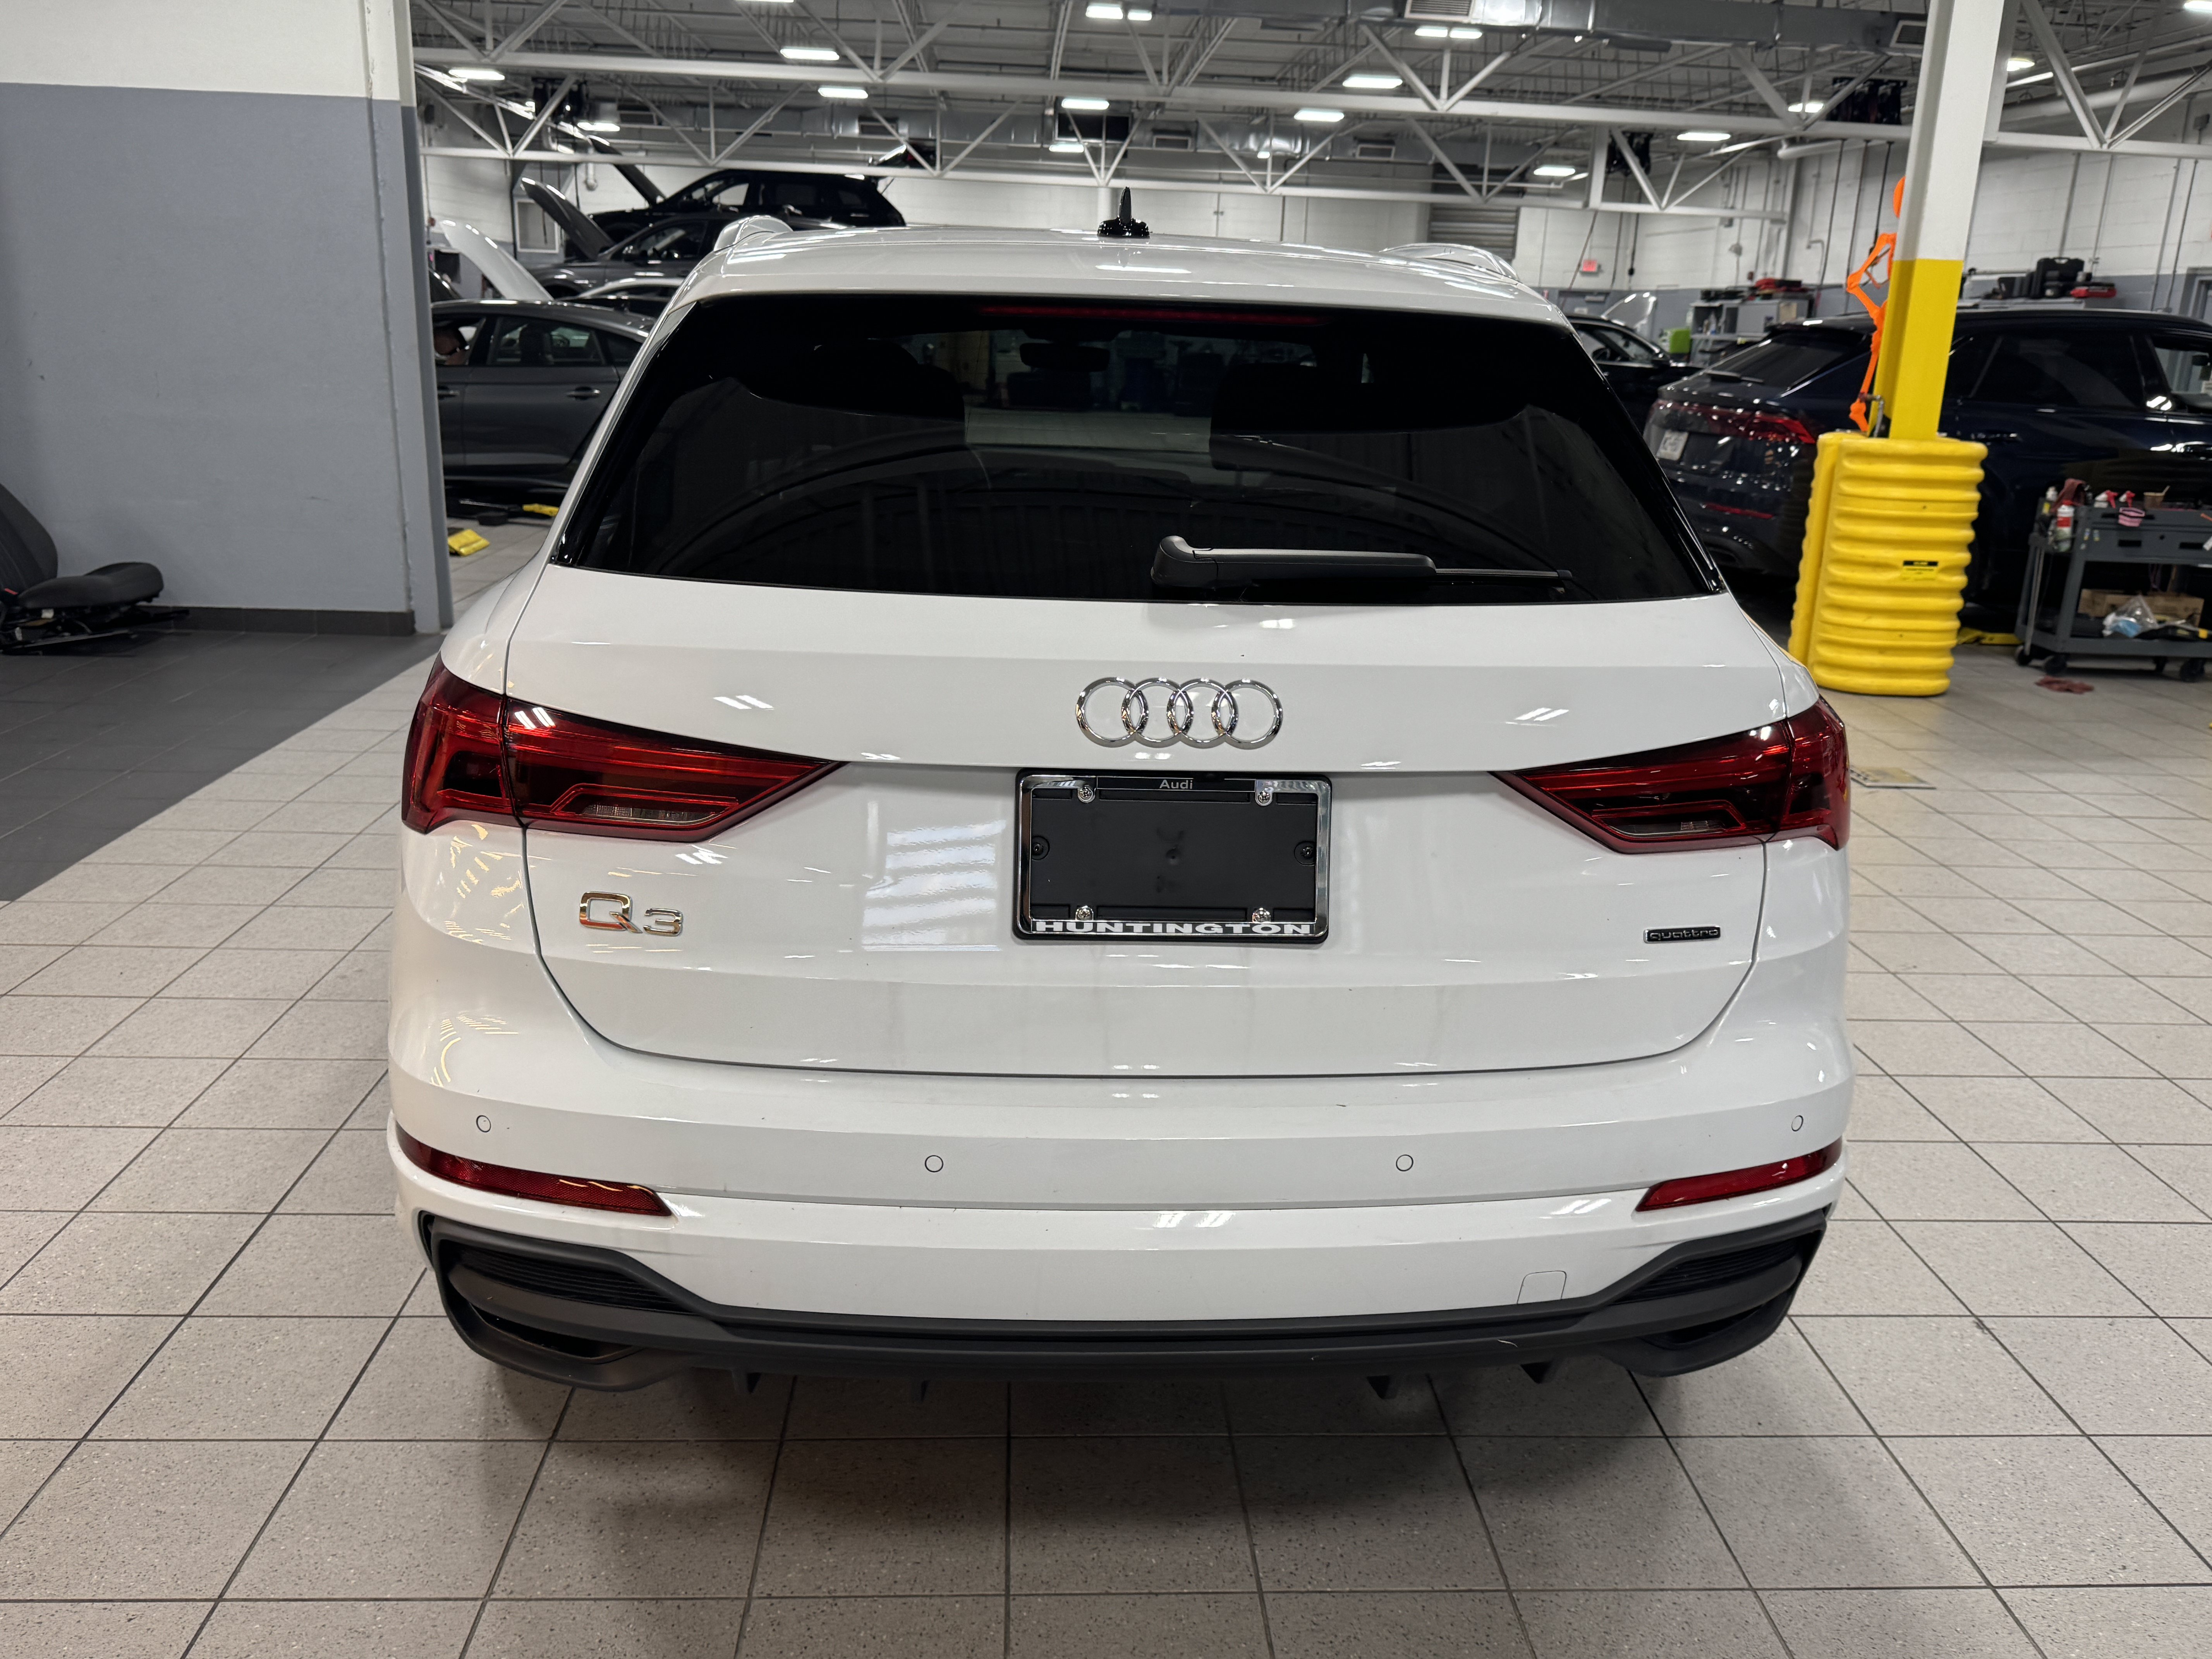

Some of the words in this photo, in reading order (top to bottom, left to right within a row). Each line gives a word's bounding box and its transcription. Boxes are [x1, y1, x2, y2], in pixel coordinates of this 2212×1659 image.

[1159, 779, 1192, 789] Audi
[579, 891, 683, 936] Q3
[1036, 922, 1310, 934] HUNTINGTON
[1650, 929, 1718, 940] quattro
